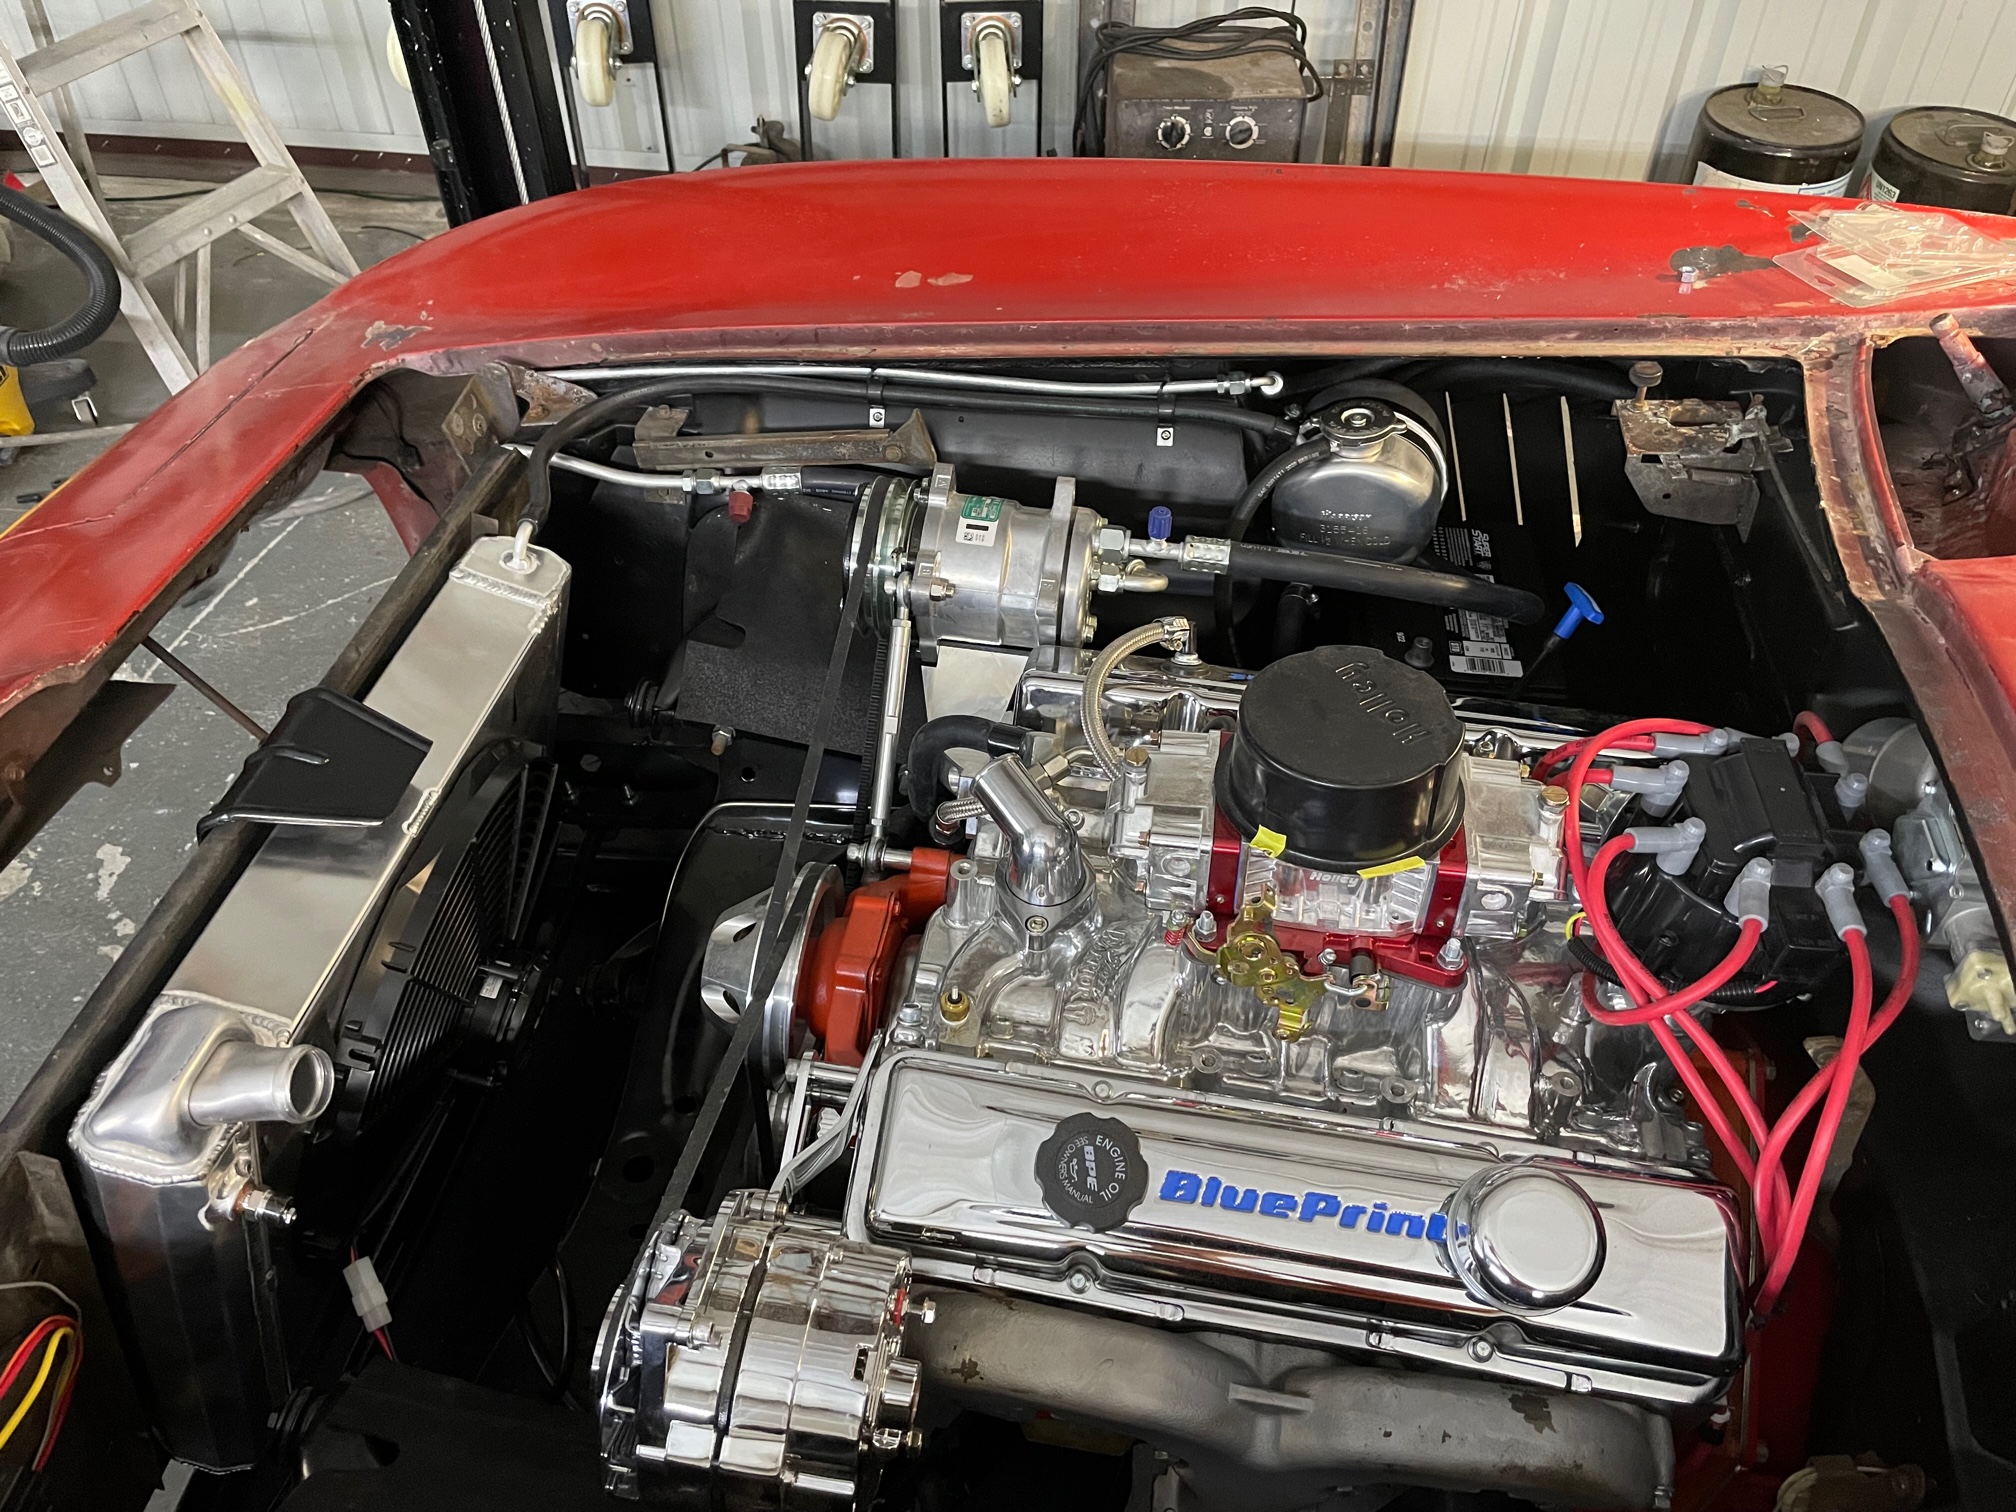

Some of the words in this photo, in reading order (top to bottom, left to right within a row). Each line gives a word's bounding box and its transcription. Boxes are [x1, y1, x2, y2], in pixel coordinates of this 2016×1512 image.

[1335, 661, 1434, 746] Holley
[1074, 1136, 1089, 1148] SEE
[1095, 1134, 1126, 1180] ENGINE
[1083, 1145, 1098, 1192] BPE
[1061, 1179, 1094, 1204] MANUAL
[1099, 1182, 1120, 1202] OIL
